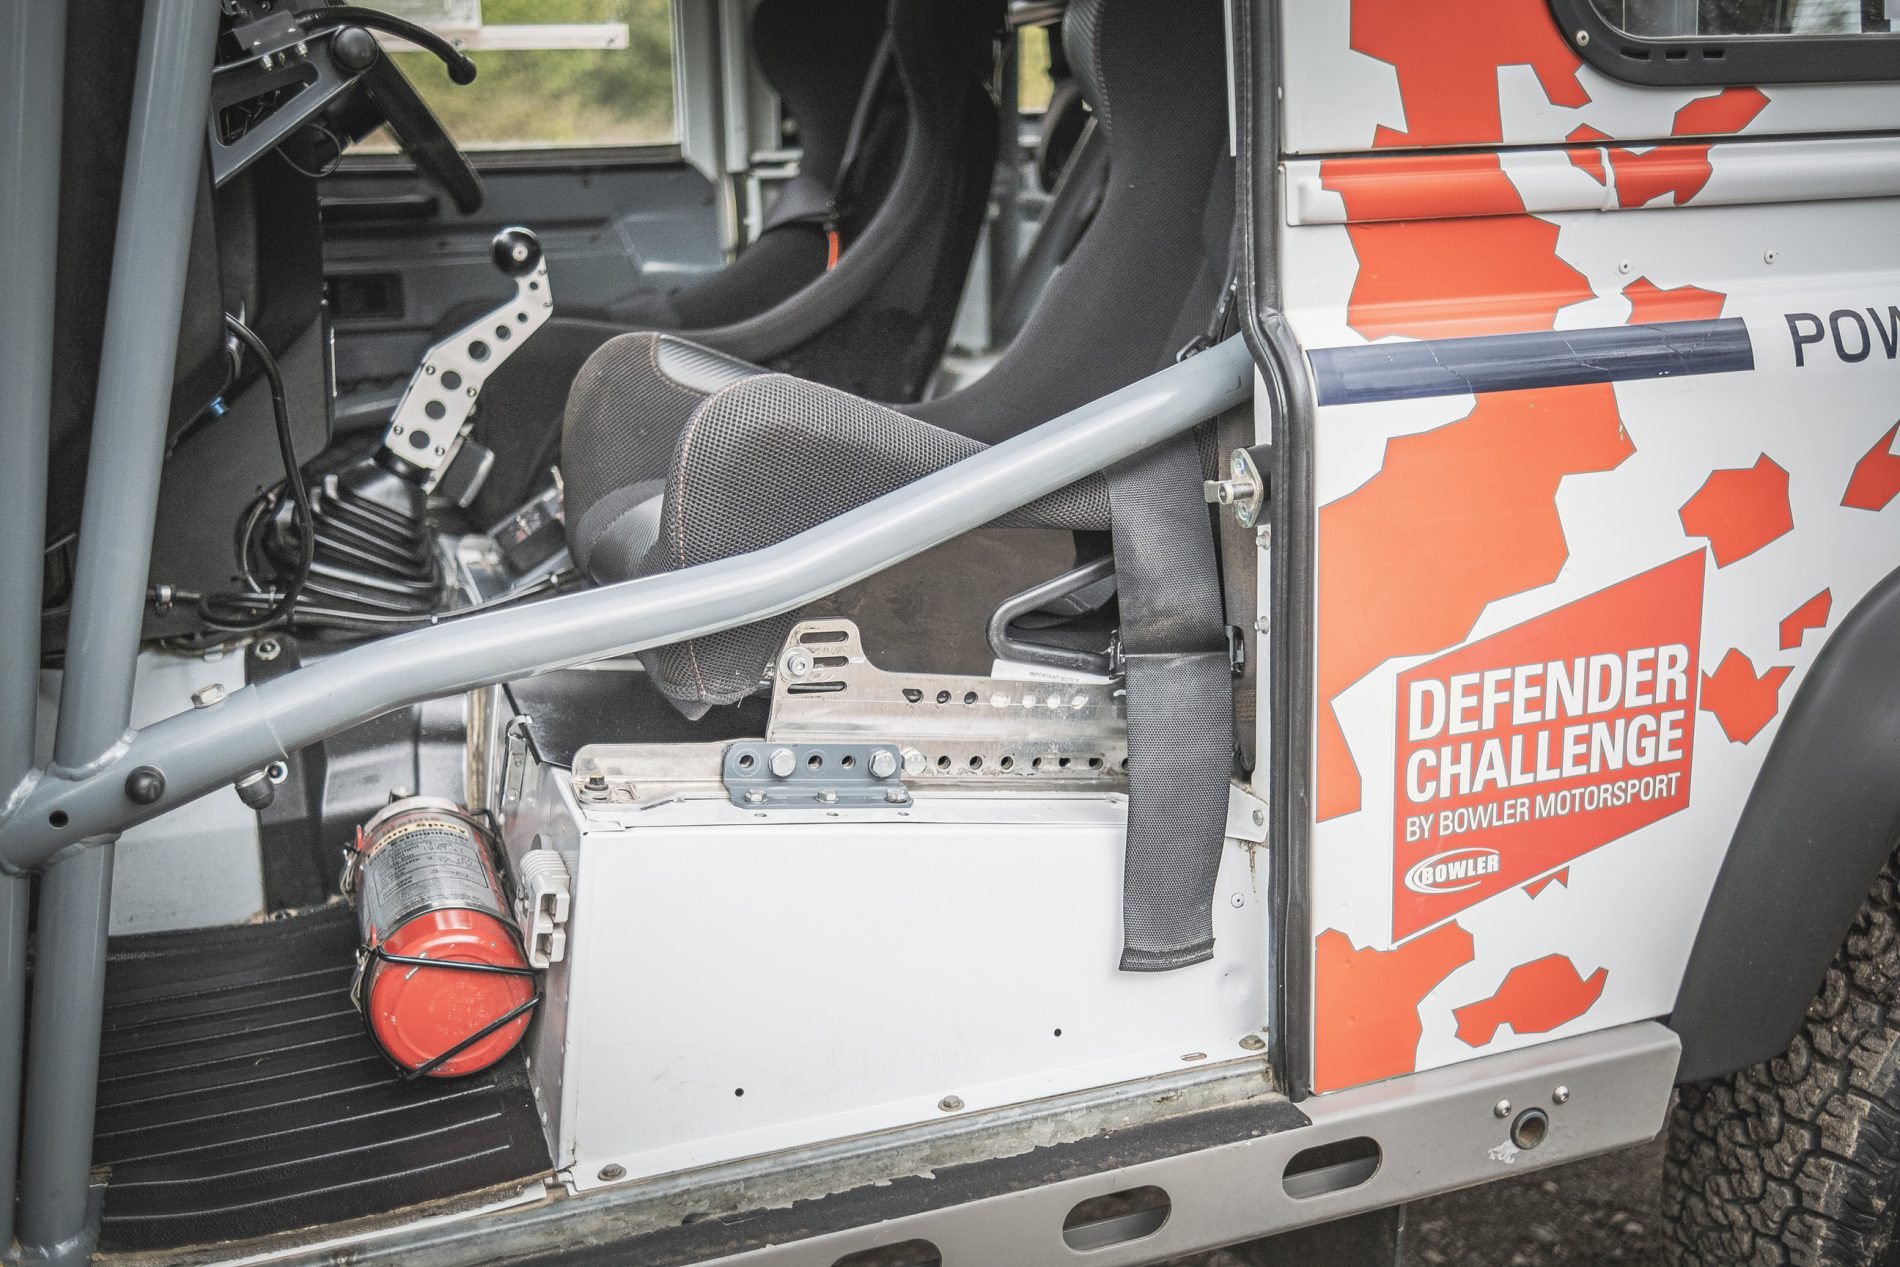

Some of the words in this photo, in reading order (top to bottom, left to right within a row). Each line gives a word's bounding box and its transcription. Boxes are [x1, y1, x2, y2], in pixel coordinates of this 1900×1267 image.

[1028, 671, 1060, 681] IMPORTANT
[1408, 643, 1689, 742] DEFENDER
[1406, 709, 1686, 802] CHALLENGE
[1406, 813, 1434, 842] BY
[1439, 797, 1529, 836] BOWLER
[1535, 772, 1681, 819] MOTORSPORT
[1421, 854, 1499, 885] BOWLER
